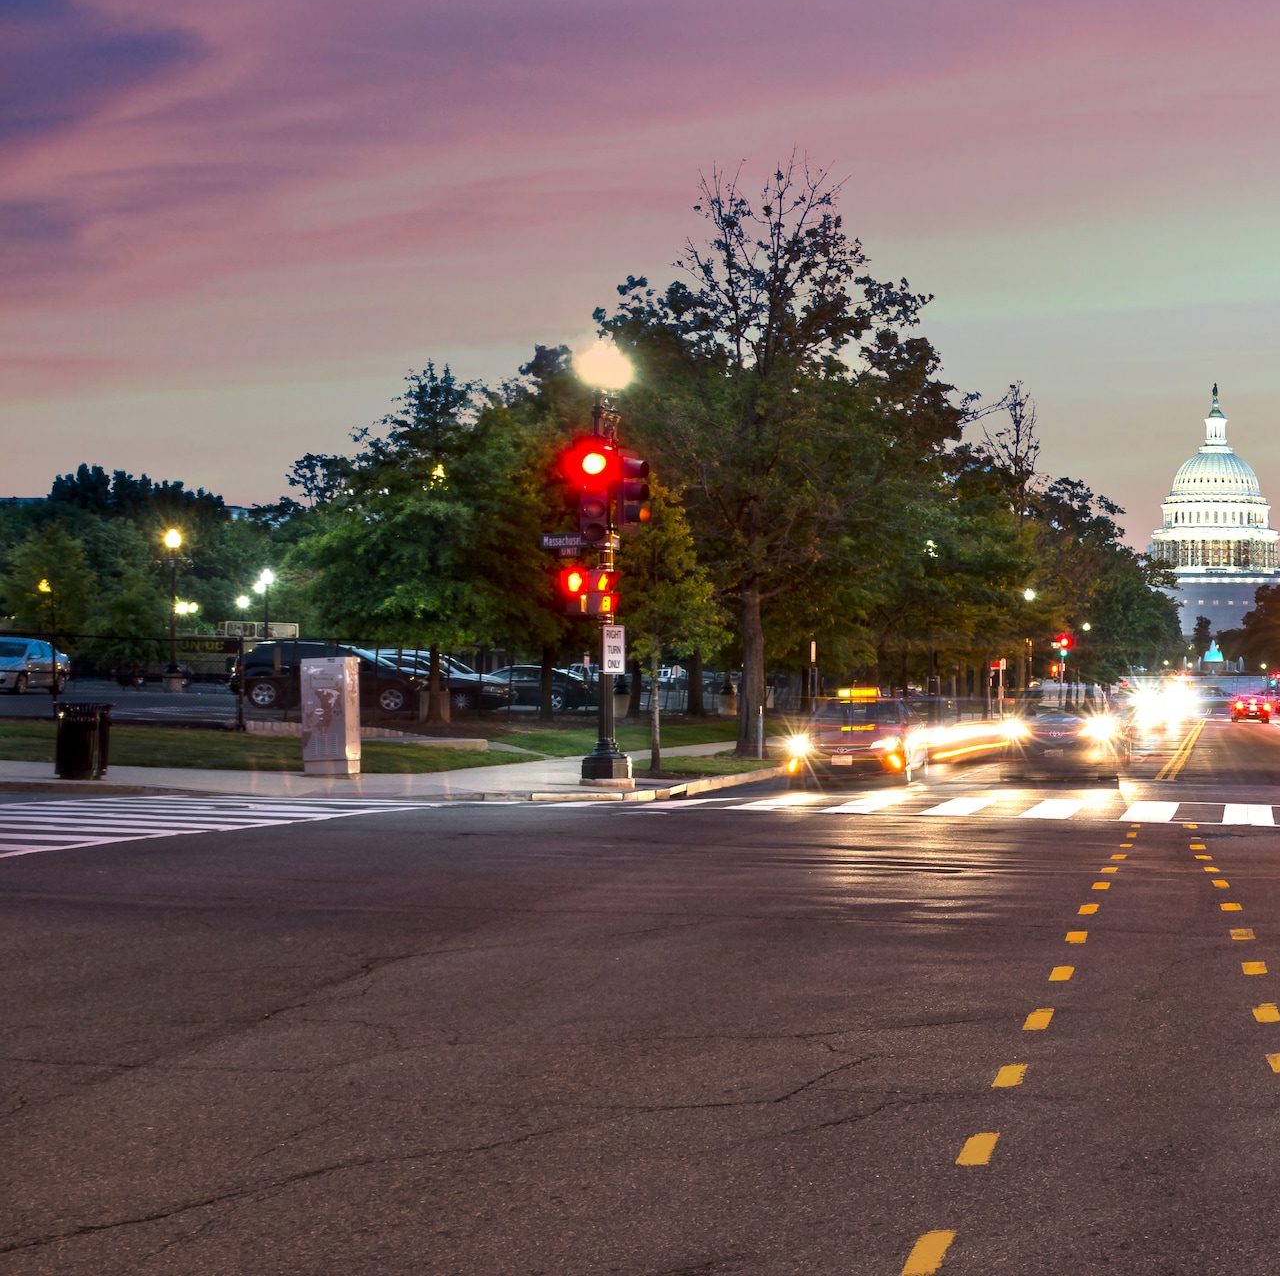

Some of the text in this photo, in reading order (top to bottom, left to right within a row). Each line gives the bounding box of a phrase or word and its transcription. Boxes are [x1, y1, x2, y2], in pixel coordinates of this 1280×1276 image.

[543, 536, 582, 547] Massachuse
[561, 548, 578, 556] UNIT
[606, 629, 622, 639] RIGHT
[607, 645, 622, 655] TURN
[607, 659, 621, 669] ONLY
